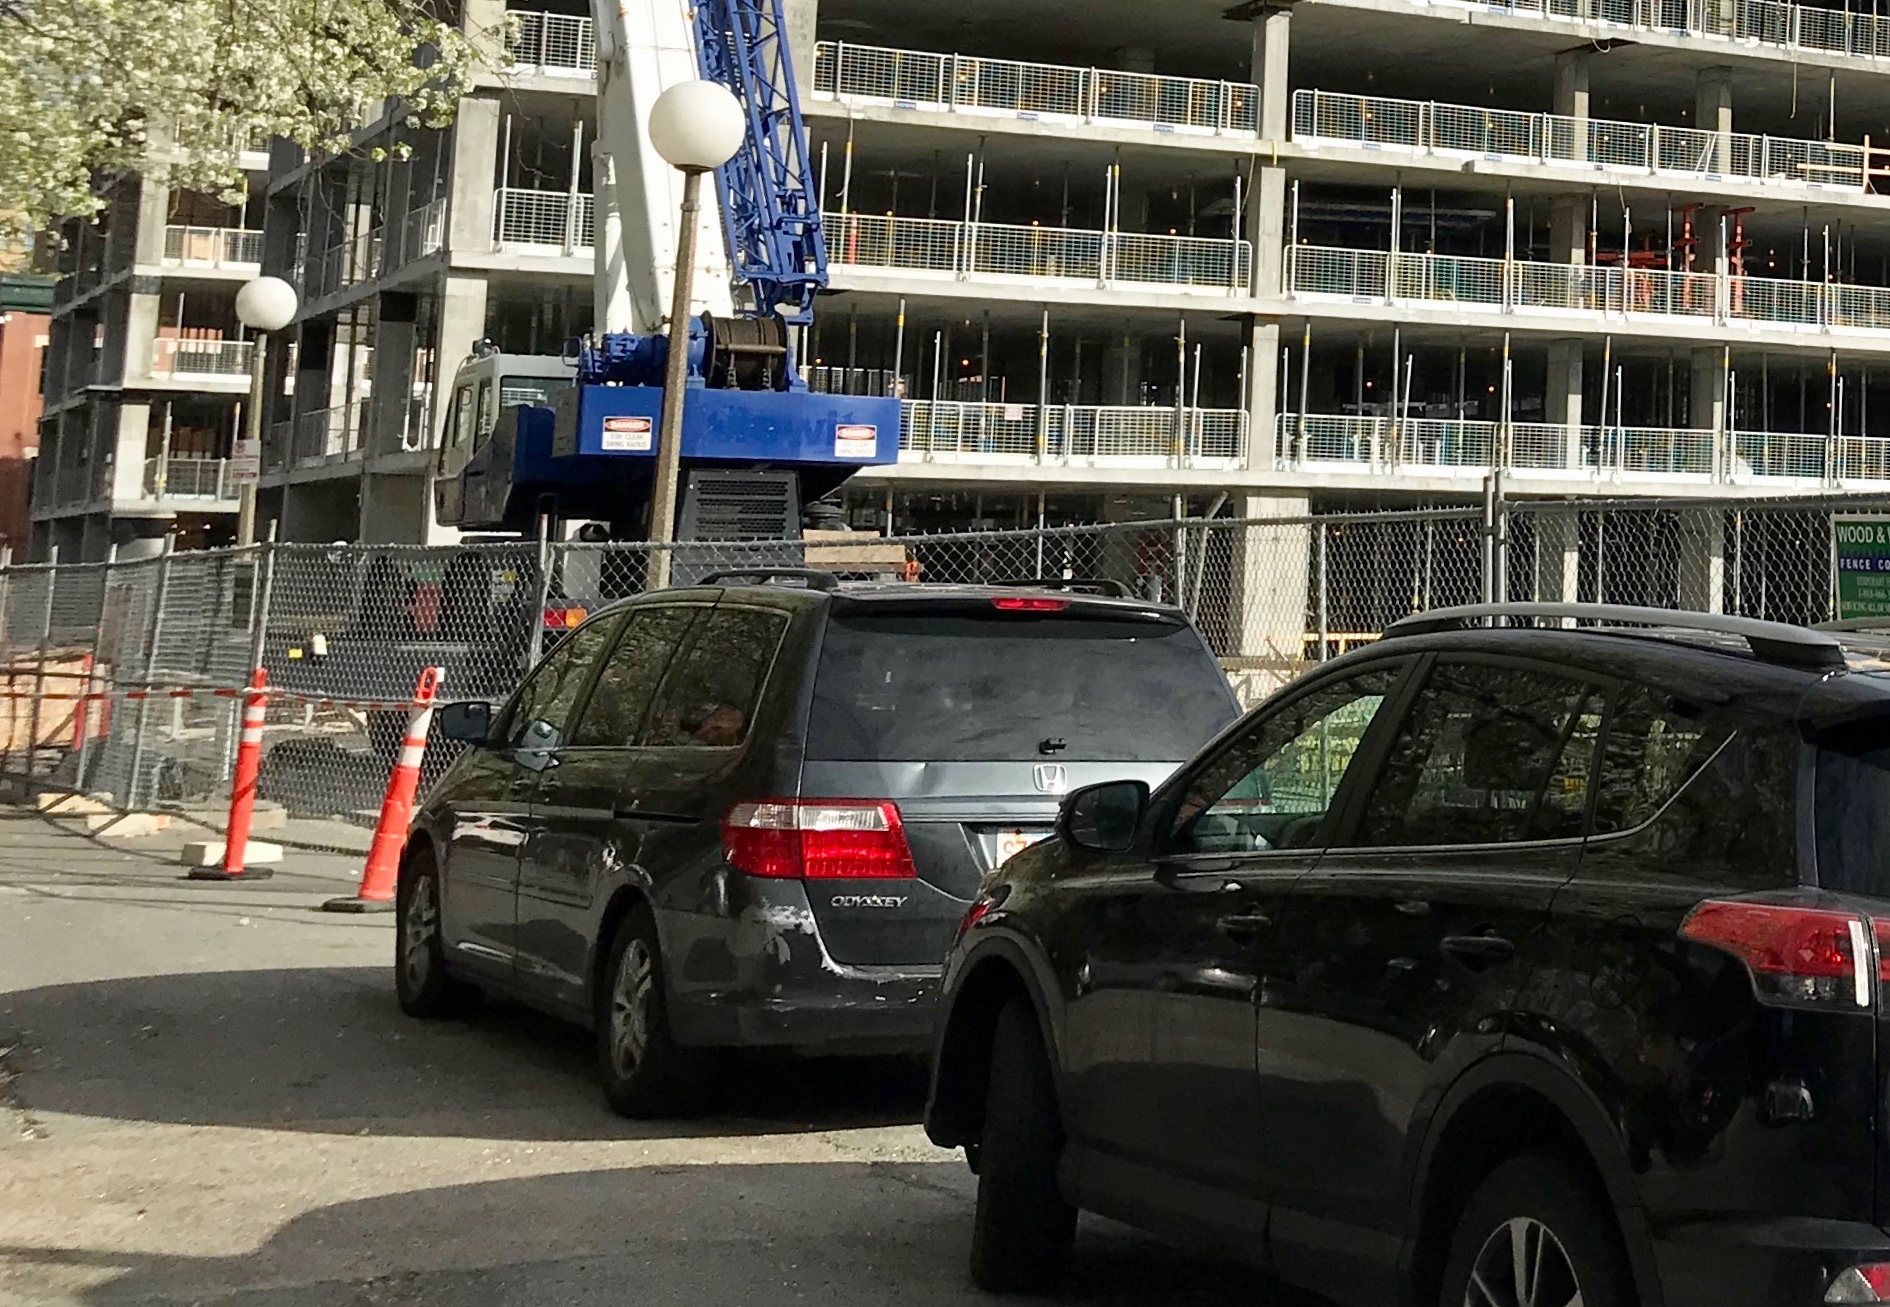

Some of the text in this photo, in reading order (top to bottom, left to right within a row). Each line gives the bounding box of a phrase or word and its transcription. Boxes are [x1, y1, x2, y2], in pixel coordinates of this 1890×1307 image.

[1837, 525, 1873, 543] WOOD
[1876, 526, 1886, 544] &
[1840, 558, 1871, 570] FENCE
[1878, 559, 1890, 571] CO
[831, 895, 908, 907] ODYSSEY
